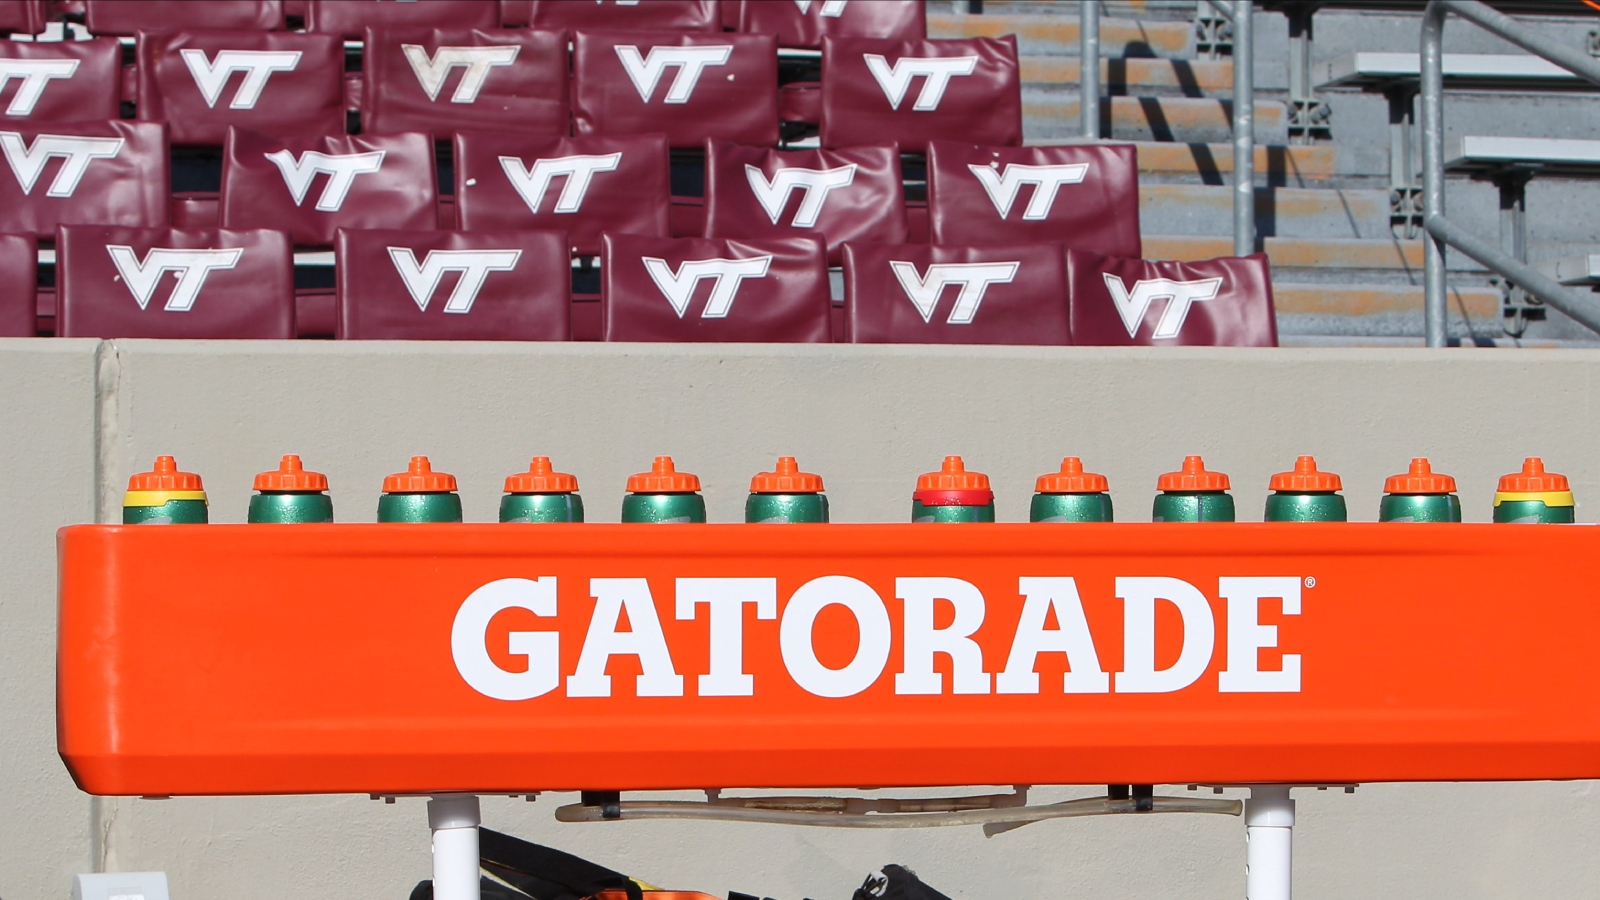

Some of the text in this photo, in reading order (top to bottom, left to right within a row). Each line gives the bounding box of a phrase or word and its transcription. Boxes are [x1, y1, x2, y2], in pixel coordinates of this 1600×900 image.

[180, 49, 302, 110] VT
[402, 44, 521, 103] VT
[614, 44, 734, 103] VT
[863, 53, 978, 111] VT
[0, 131, 125, 197] VT
[264, 149, 387, 212] VT
[498, 152, 623, 213] VT
[744, 163, 858, 228] VT
[967, 163, 1089, 220] VT
[106, 244, 244, 311] VT
[387, 247, 522, 313] VT
[641, 254, 774, 319] VT
[889, 261, 1020, 324] VT
[1102, 272, 1223, 340] VT
[451, 575, 1302, 700] GATORADE
